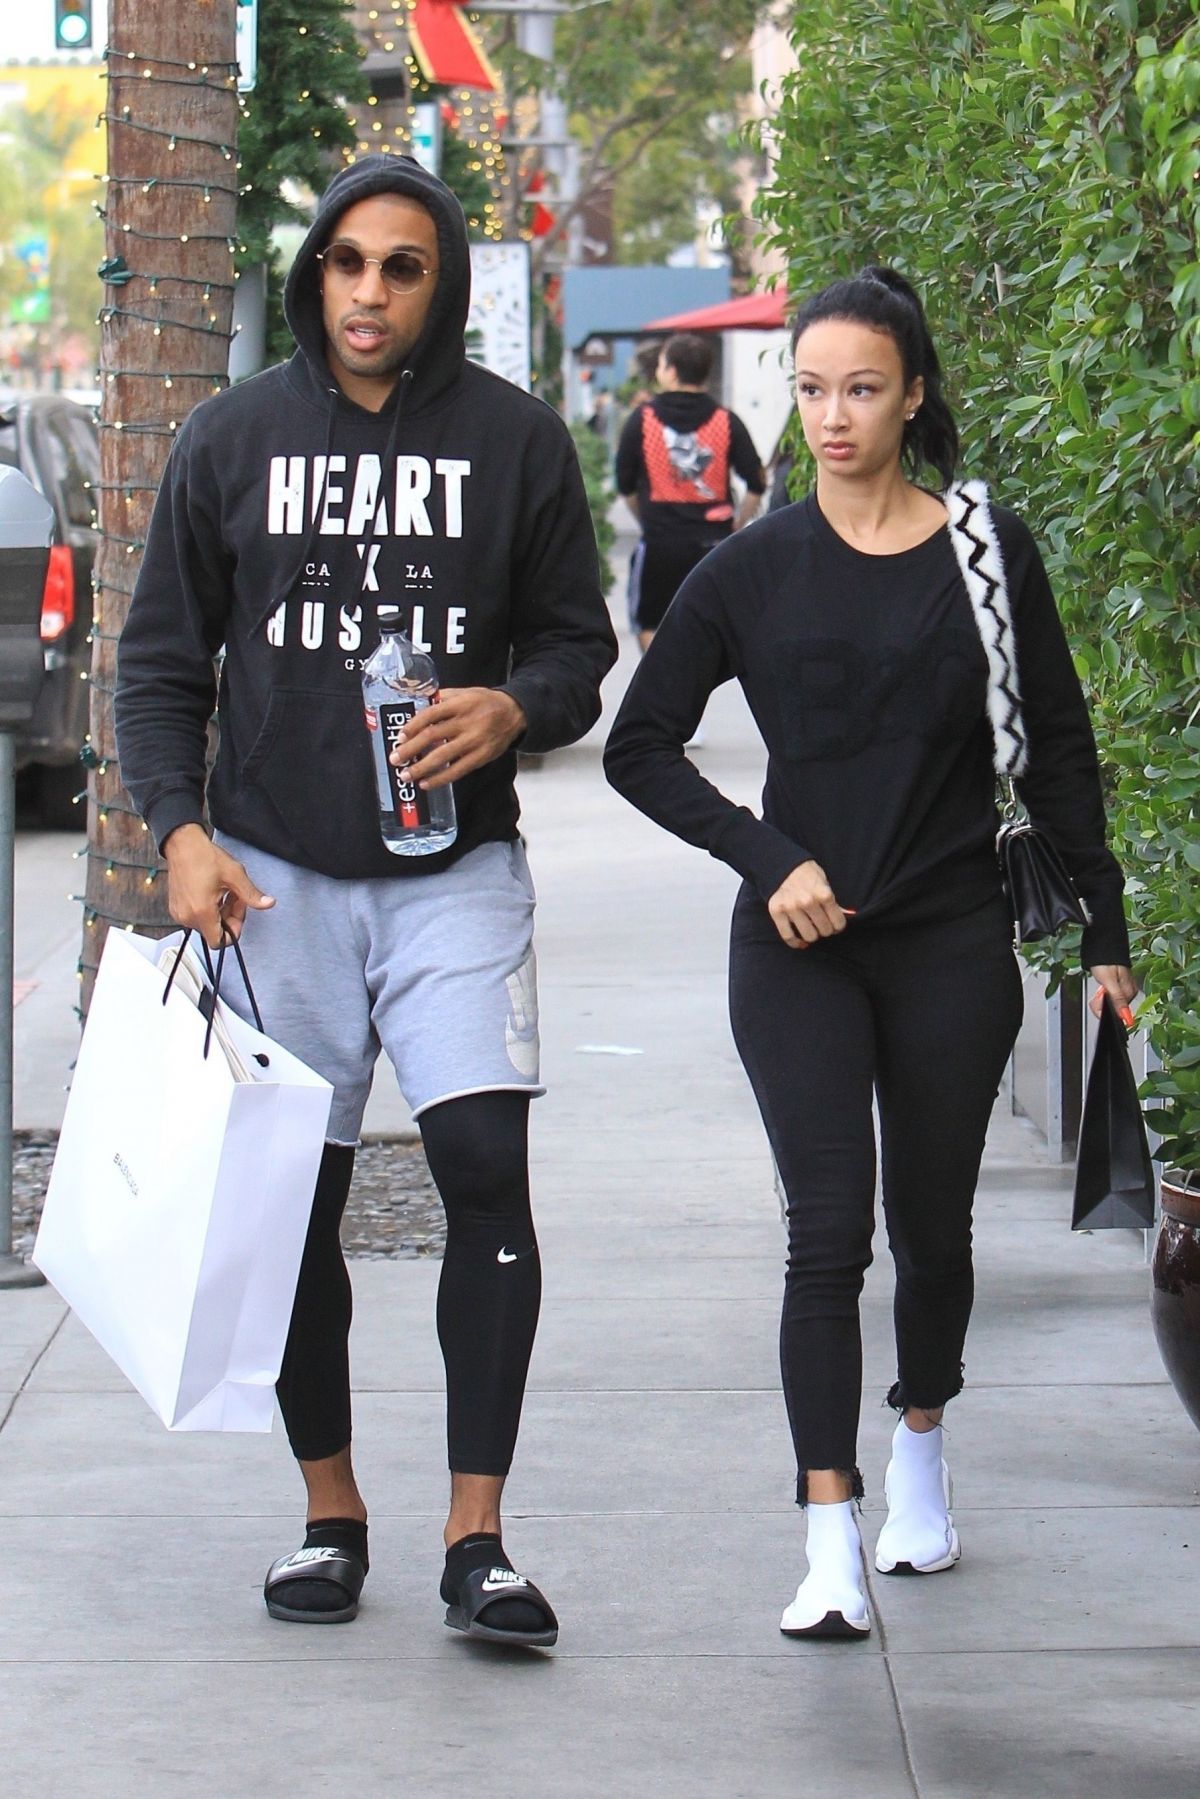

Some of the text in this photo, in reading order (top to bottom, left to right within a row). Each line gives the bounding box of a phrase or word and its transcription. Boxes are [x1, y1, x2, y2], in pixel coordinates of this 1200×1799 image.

[267, 453, 471, 538] HEART
[305, 543, 433, 591] CA X LA
[289, 1546, 340, 1565] NIKE
[489, 1567, 528, 1586] NIKE
